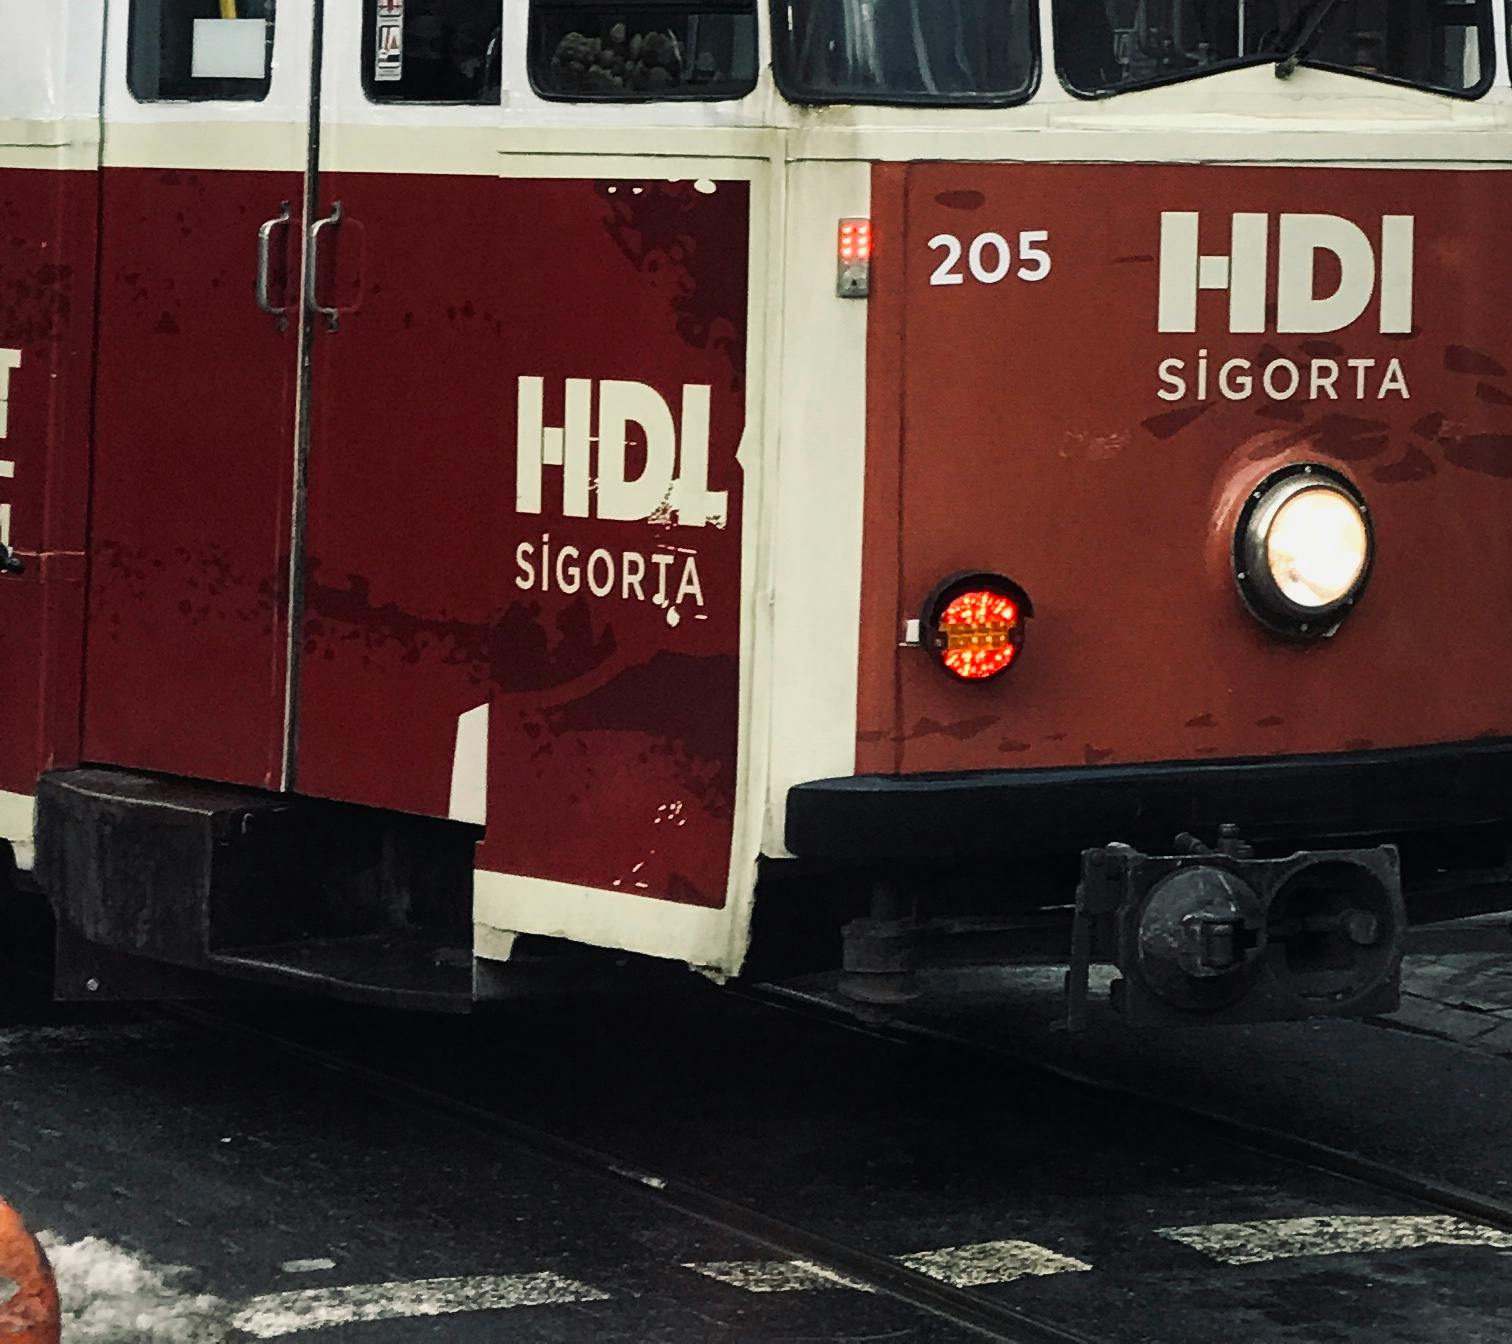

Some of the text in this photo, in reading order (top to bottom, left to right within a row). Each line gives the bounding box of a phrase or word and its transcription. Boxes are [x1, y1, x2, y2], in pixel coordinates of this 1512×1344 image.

[928, 230, 1052, 286] 205
[1158, 211, 1414, 334] HDI
[1158, 349, 1410, 402] SİGORTA
[515, 532, 704, 608] SİGORTA
